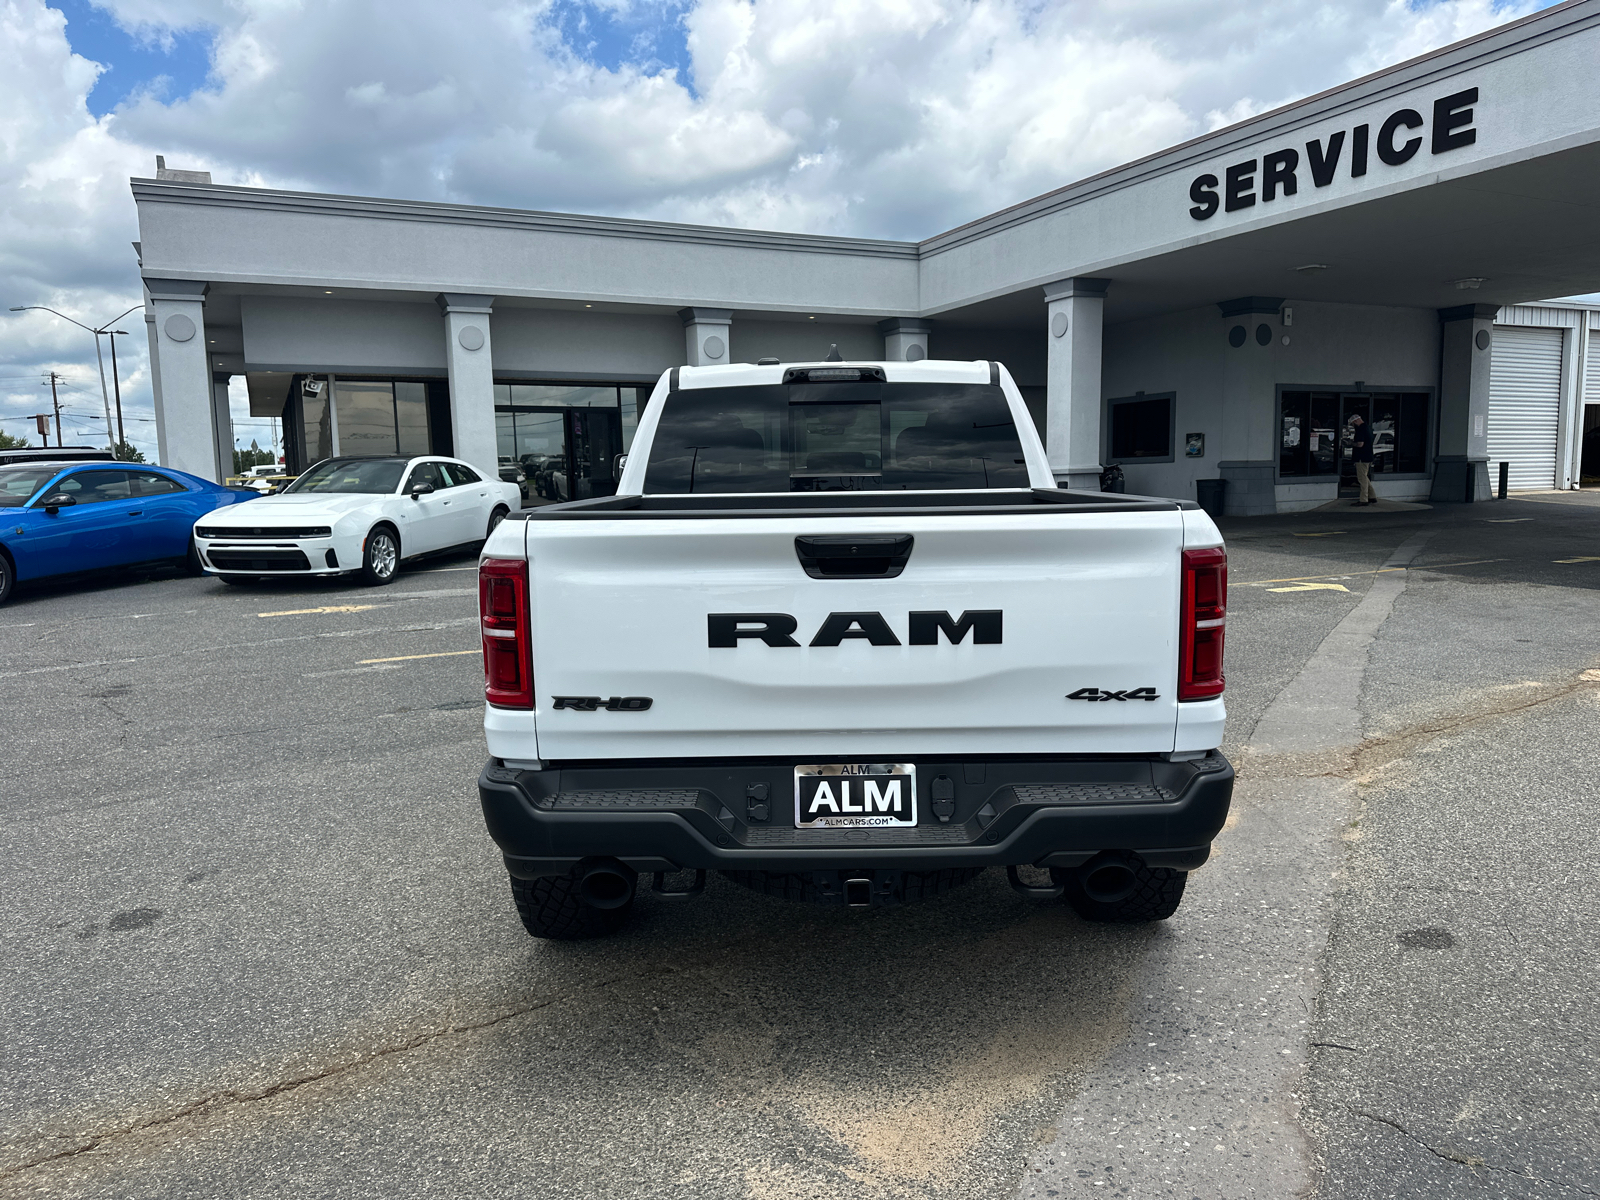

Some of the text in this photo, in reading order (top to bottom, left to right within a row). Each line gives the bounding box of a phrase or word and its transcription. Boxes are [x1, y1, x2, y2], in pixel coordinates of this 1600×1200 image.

[1189, 87, 1478, 220] SERVICE
[707, 609, 1003, 648] RAM
[1064, 687, 1161, 702] 4x4
[551, 695, 653, 711] RHO
[841, 764, 870, 775] ALM
[808, 780, 902, 813] ALM
[824, 818, 889, 826] ALMCARS.COM
